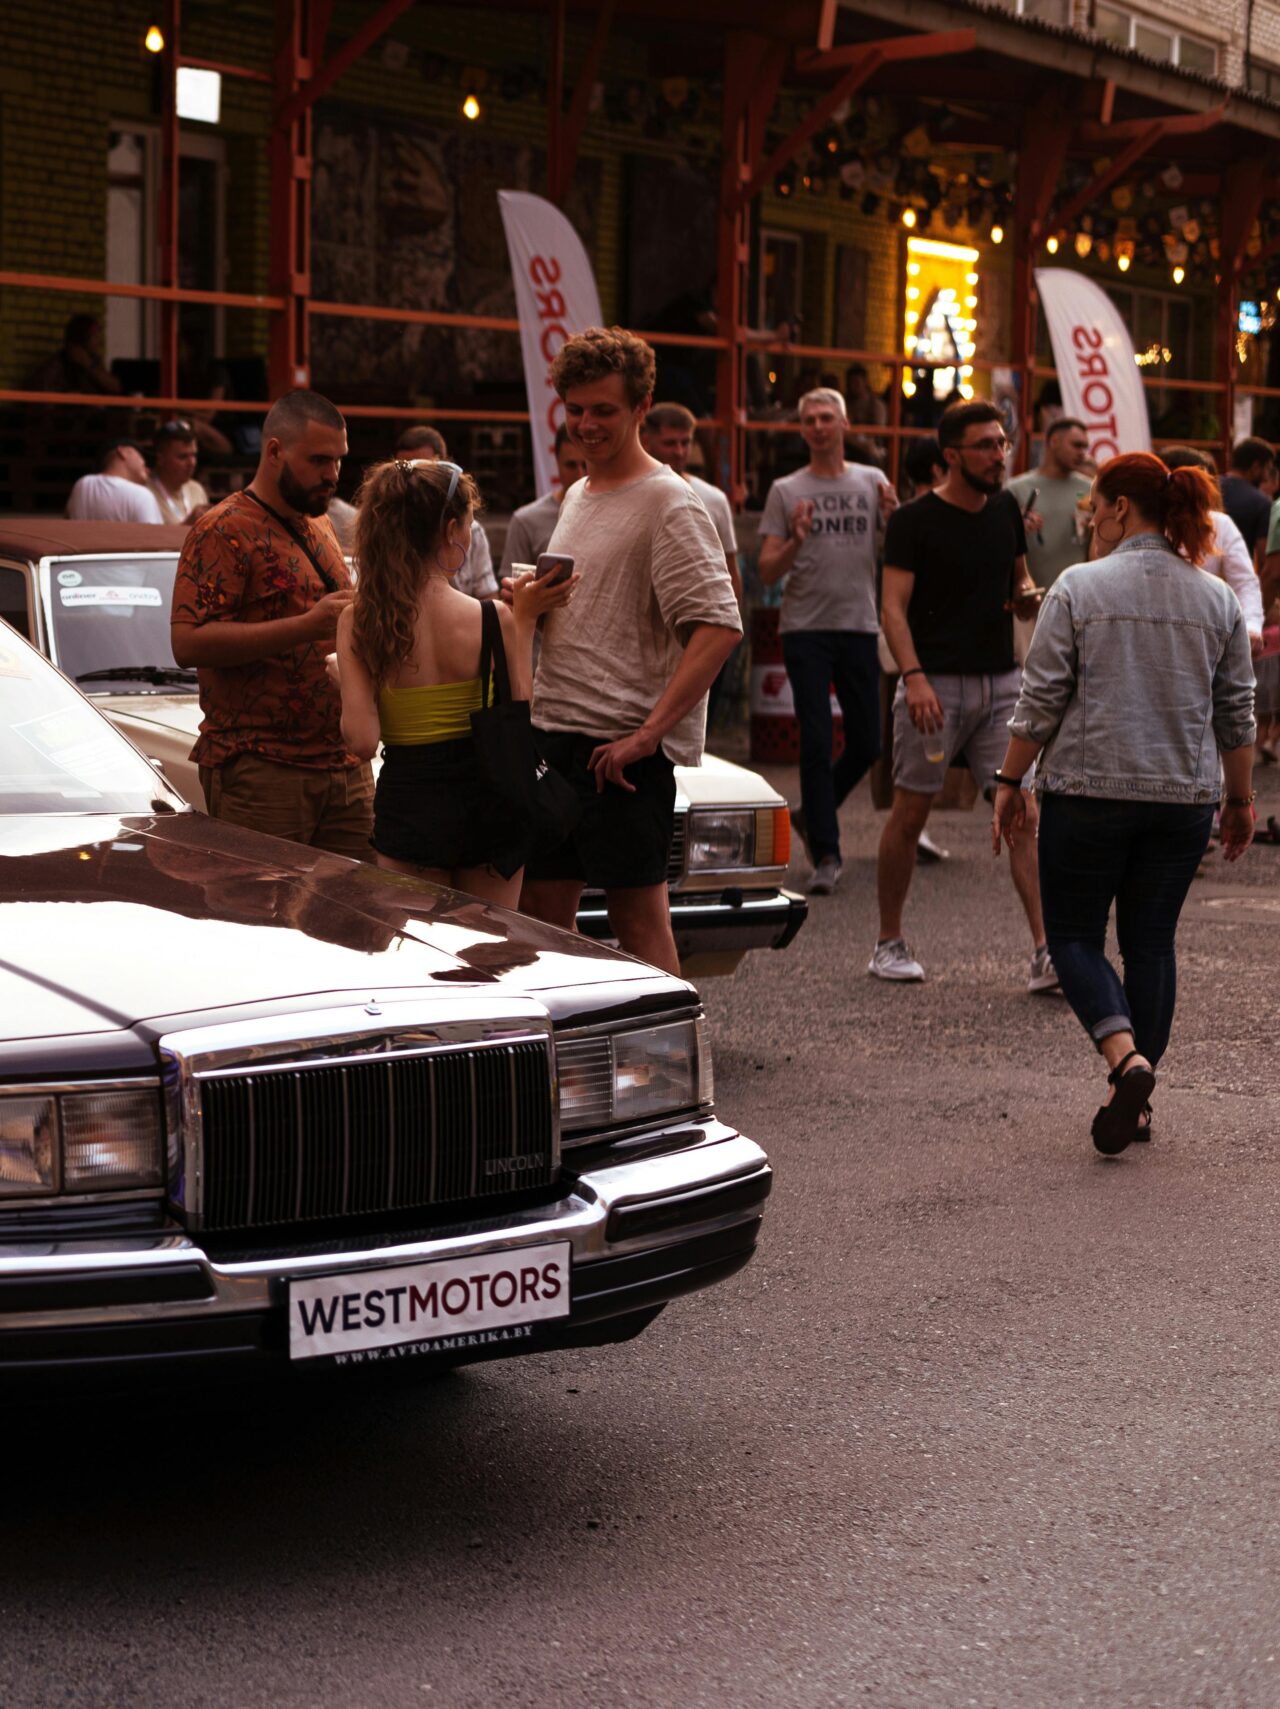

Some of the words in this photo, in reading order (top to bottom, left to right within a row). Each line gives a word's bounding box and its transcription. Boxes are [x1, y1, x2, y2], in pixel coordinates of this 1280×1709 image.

[810, 515, 868, 537] ONES
[485, 1152, 544, 1176] LINCOLN
[298, 1263, 561, 1336] WESTMOTORS
[334, 1325, 534, 1366] WWW.AVTOAMERIKA.BY
